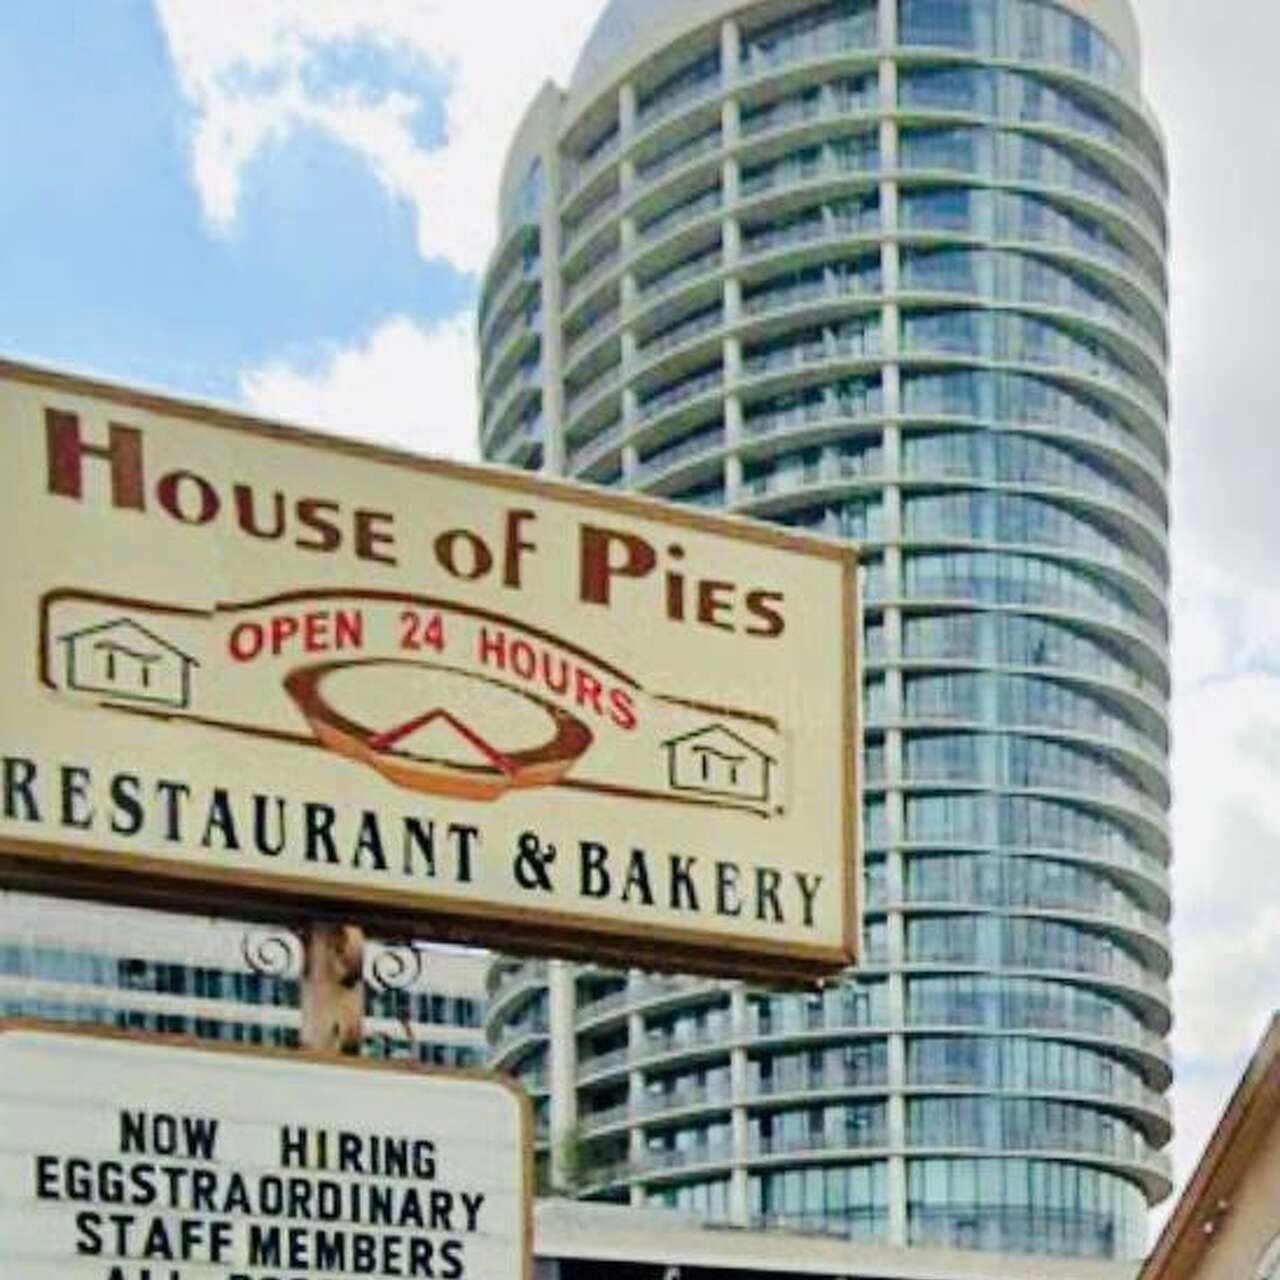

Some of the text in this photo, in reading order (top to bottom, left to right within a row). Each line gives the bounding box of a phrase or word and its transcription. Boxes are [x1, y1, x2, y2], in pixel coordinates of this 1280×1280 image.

[228, 609, 638, 730] OPEN 24 HOURS
[1, 756, 823, 928] RESTAURANT & BAKERY
[120, 1110, 437, 1180] NOW HIRING
[35, 1155, 485, 1233] EGGSTRAORDINARY
[76, 1211, 464, 1280] STAFF MEMBERS
